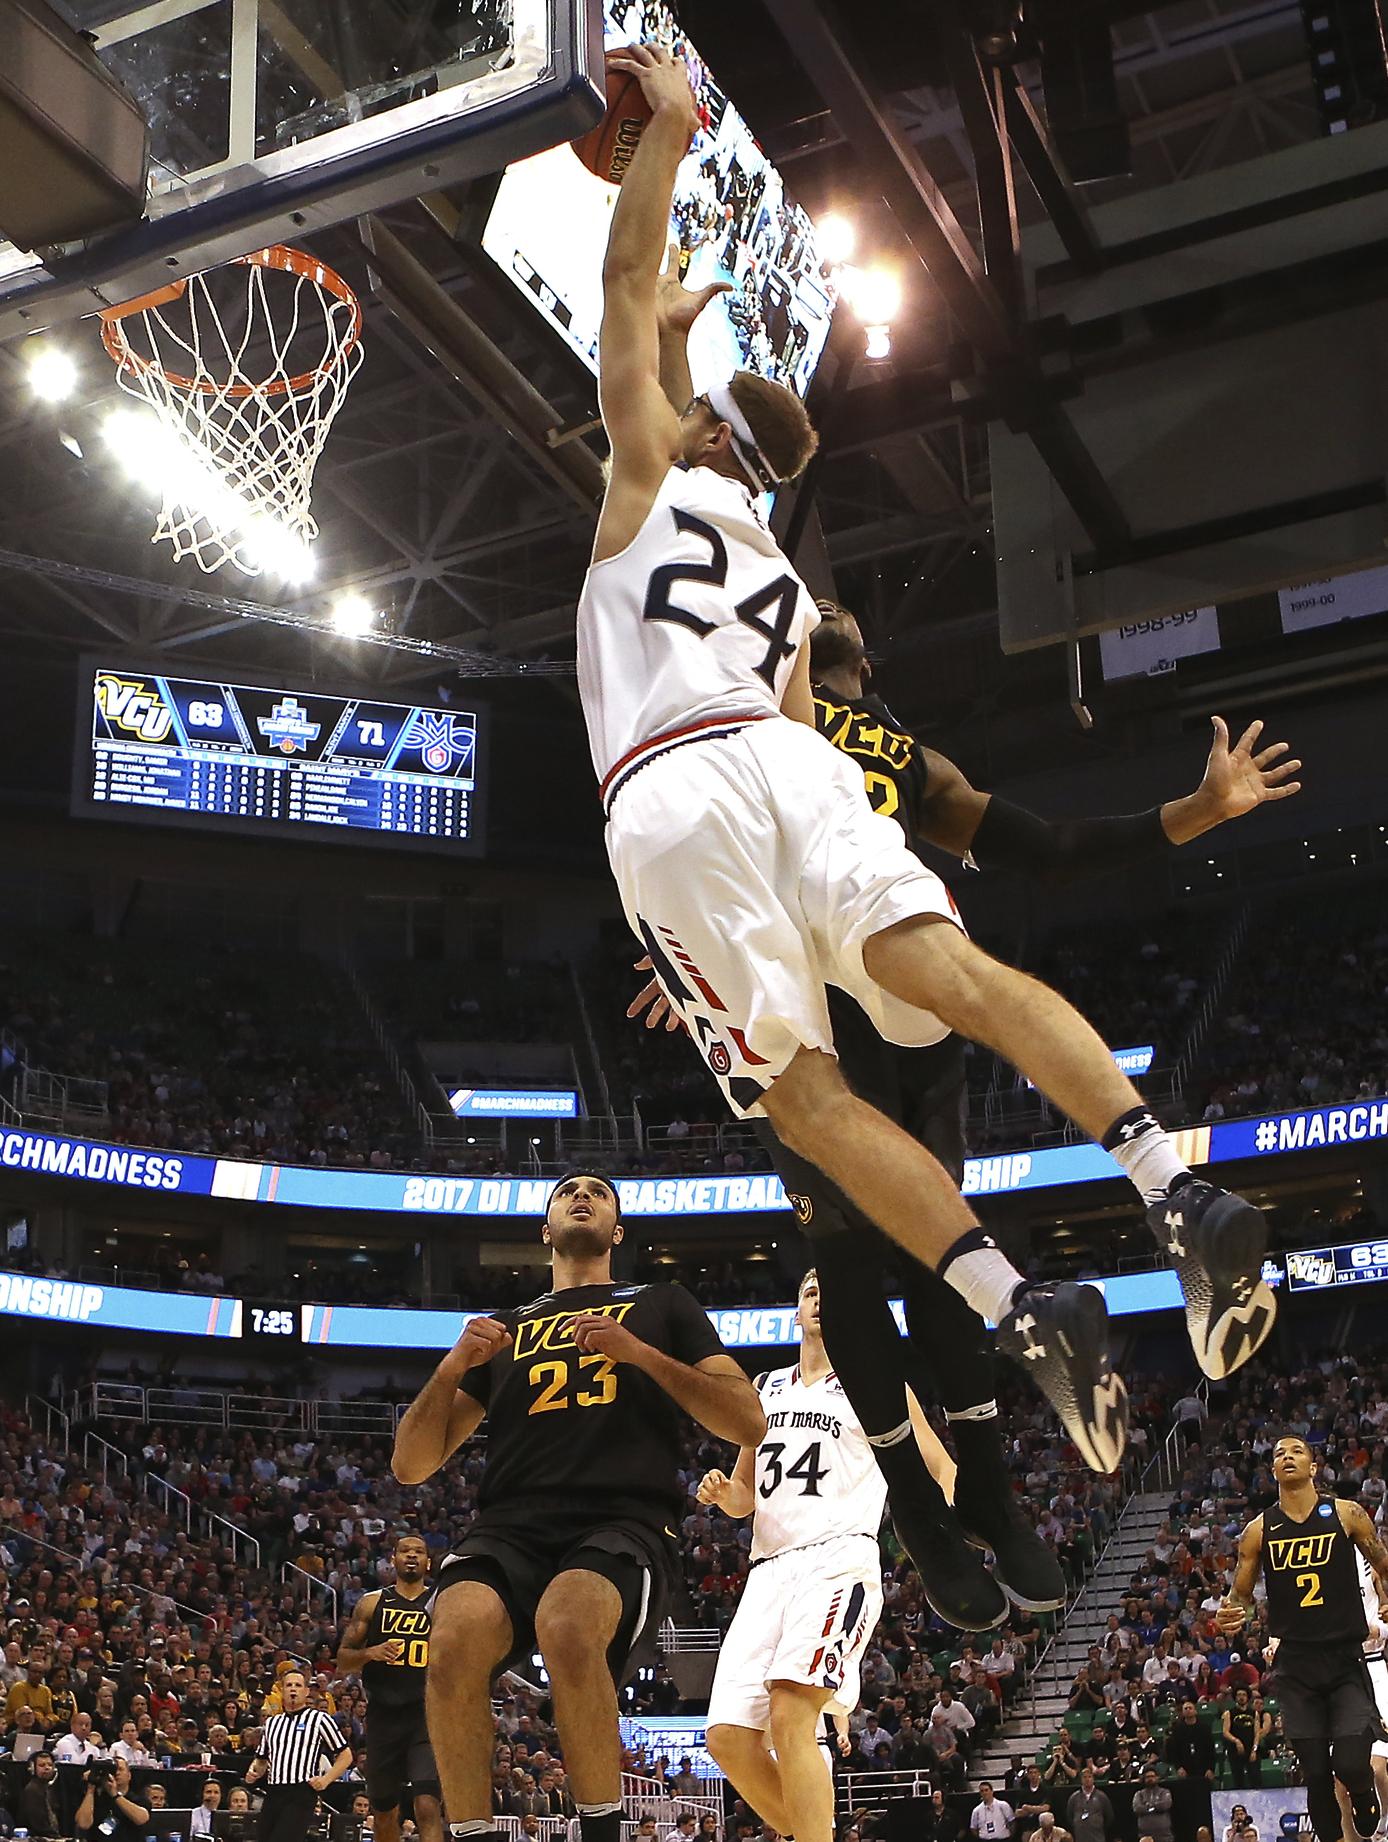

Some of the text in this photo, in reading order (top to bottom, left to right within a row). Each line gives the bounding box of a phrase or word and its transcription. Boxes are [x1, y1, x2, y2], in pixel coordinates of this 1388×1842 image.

[643, 505, 800, 695] 24
[97, 676, 172, 741] VCU
[357, 720, 386, 746] 71
[471, 1096, 573, 1112] #MARCHMADNESS
[402, 1177, 475, 1211] 2017
[1288, 1254, 1334, 1285] VCU
[251, 1308, 294, 1335] 7:25
[708, 1310, 804, 1344] SKET
[528, 1353, 618, 1416] 23
[757, 1442, 832, 1500] 34
[1268, 1532, 1337, 1571] VCU
[1296, 1572, 1324, 1608] 2
[382, 1608, 430, 1635] VCU
